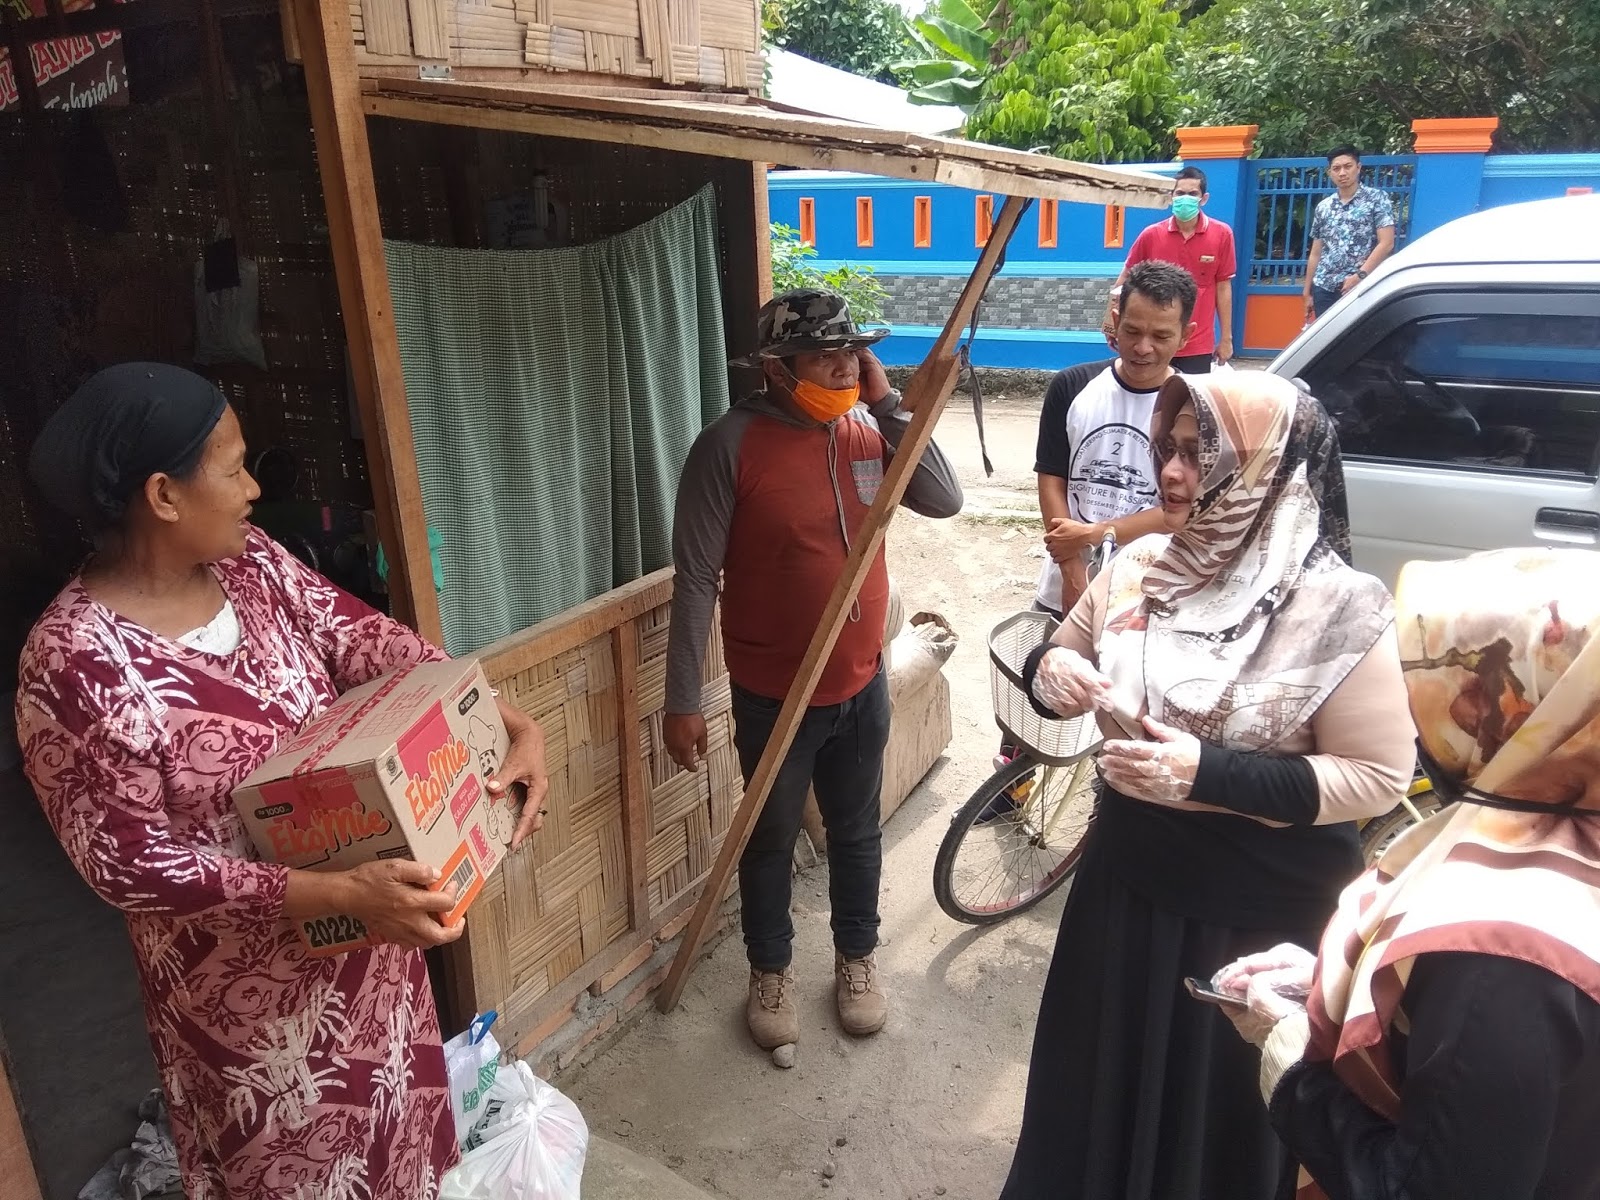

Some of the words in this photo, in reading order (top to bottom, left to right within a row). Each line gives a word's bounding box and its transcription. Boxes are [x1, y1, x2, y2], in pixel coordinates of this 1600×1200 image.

[1132, 433, 1148, 449] RETRO
[1109, 491, 1118, 499] IN
[1119, 493, 1154, 506] PASSION
[303, 914, 368, 948] 20224
